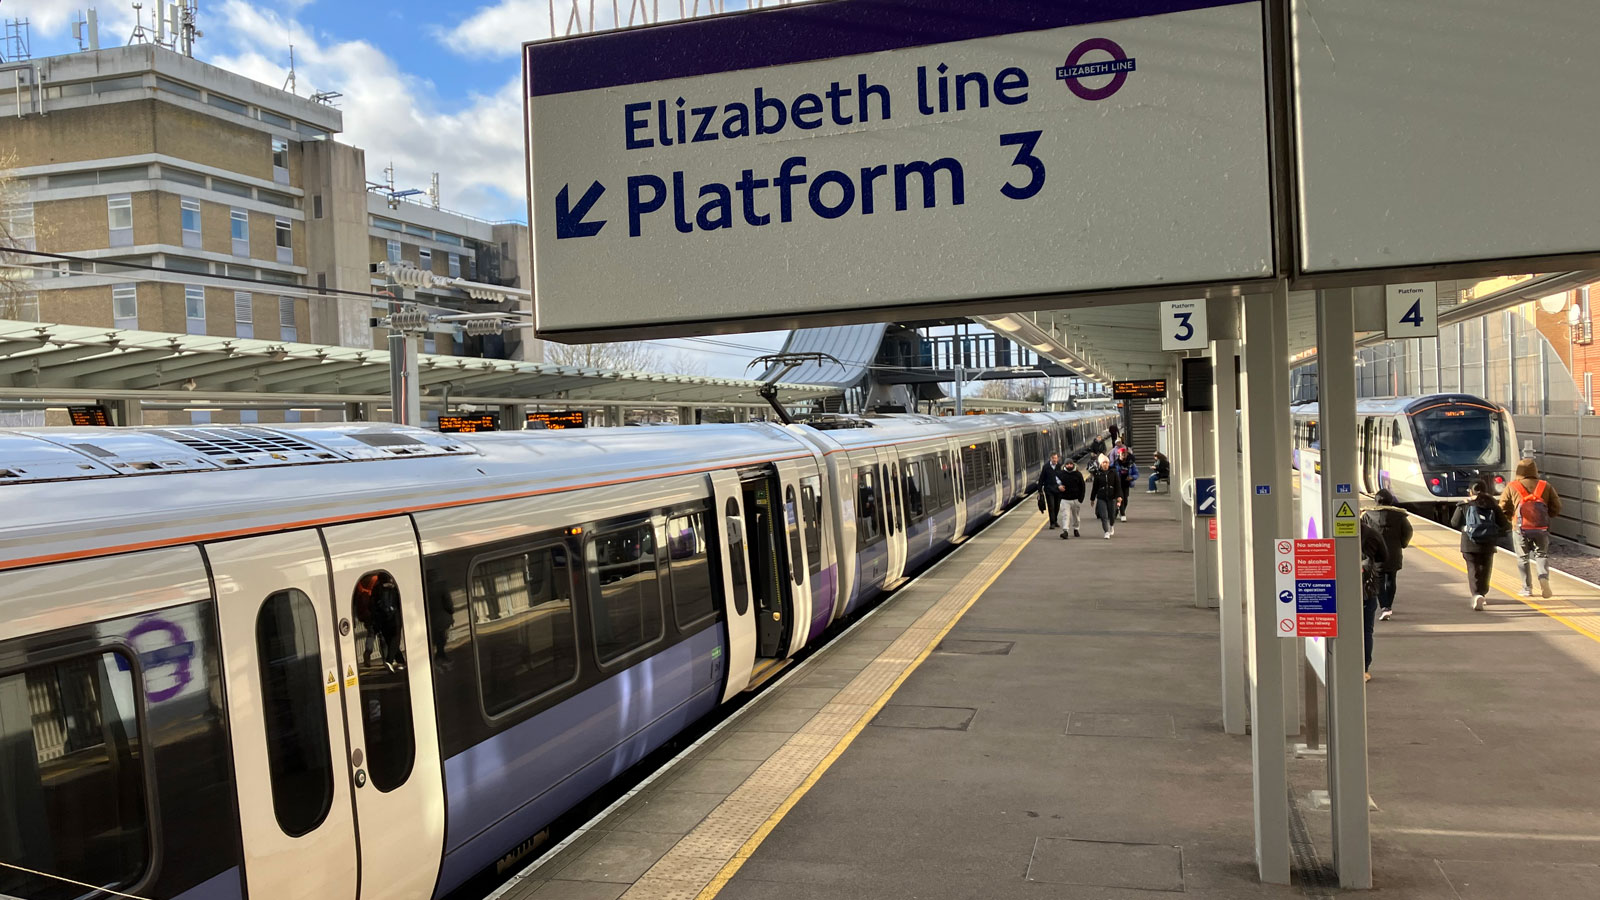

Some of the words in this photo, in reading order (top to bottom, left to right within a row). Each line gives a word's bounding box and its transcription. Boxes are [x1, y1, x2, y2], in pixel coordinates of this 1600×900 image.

[1058, 64, 1108, 77] ELIZABETH
[1111, 61, 1133, 71] LINE
[625, 74, 891, 150] Elizabeth
[917, 62, 1029, 115] line
[627, 156, 965, 237] Platform
[1000, 130, 1046, 200] 3
[1173, 312, 1194, 341] 3
[1399, 297, 1424, 327] 4
